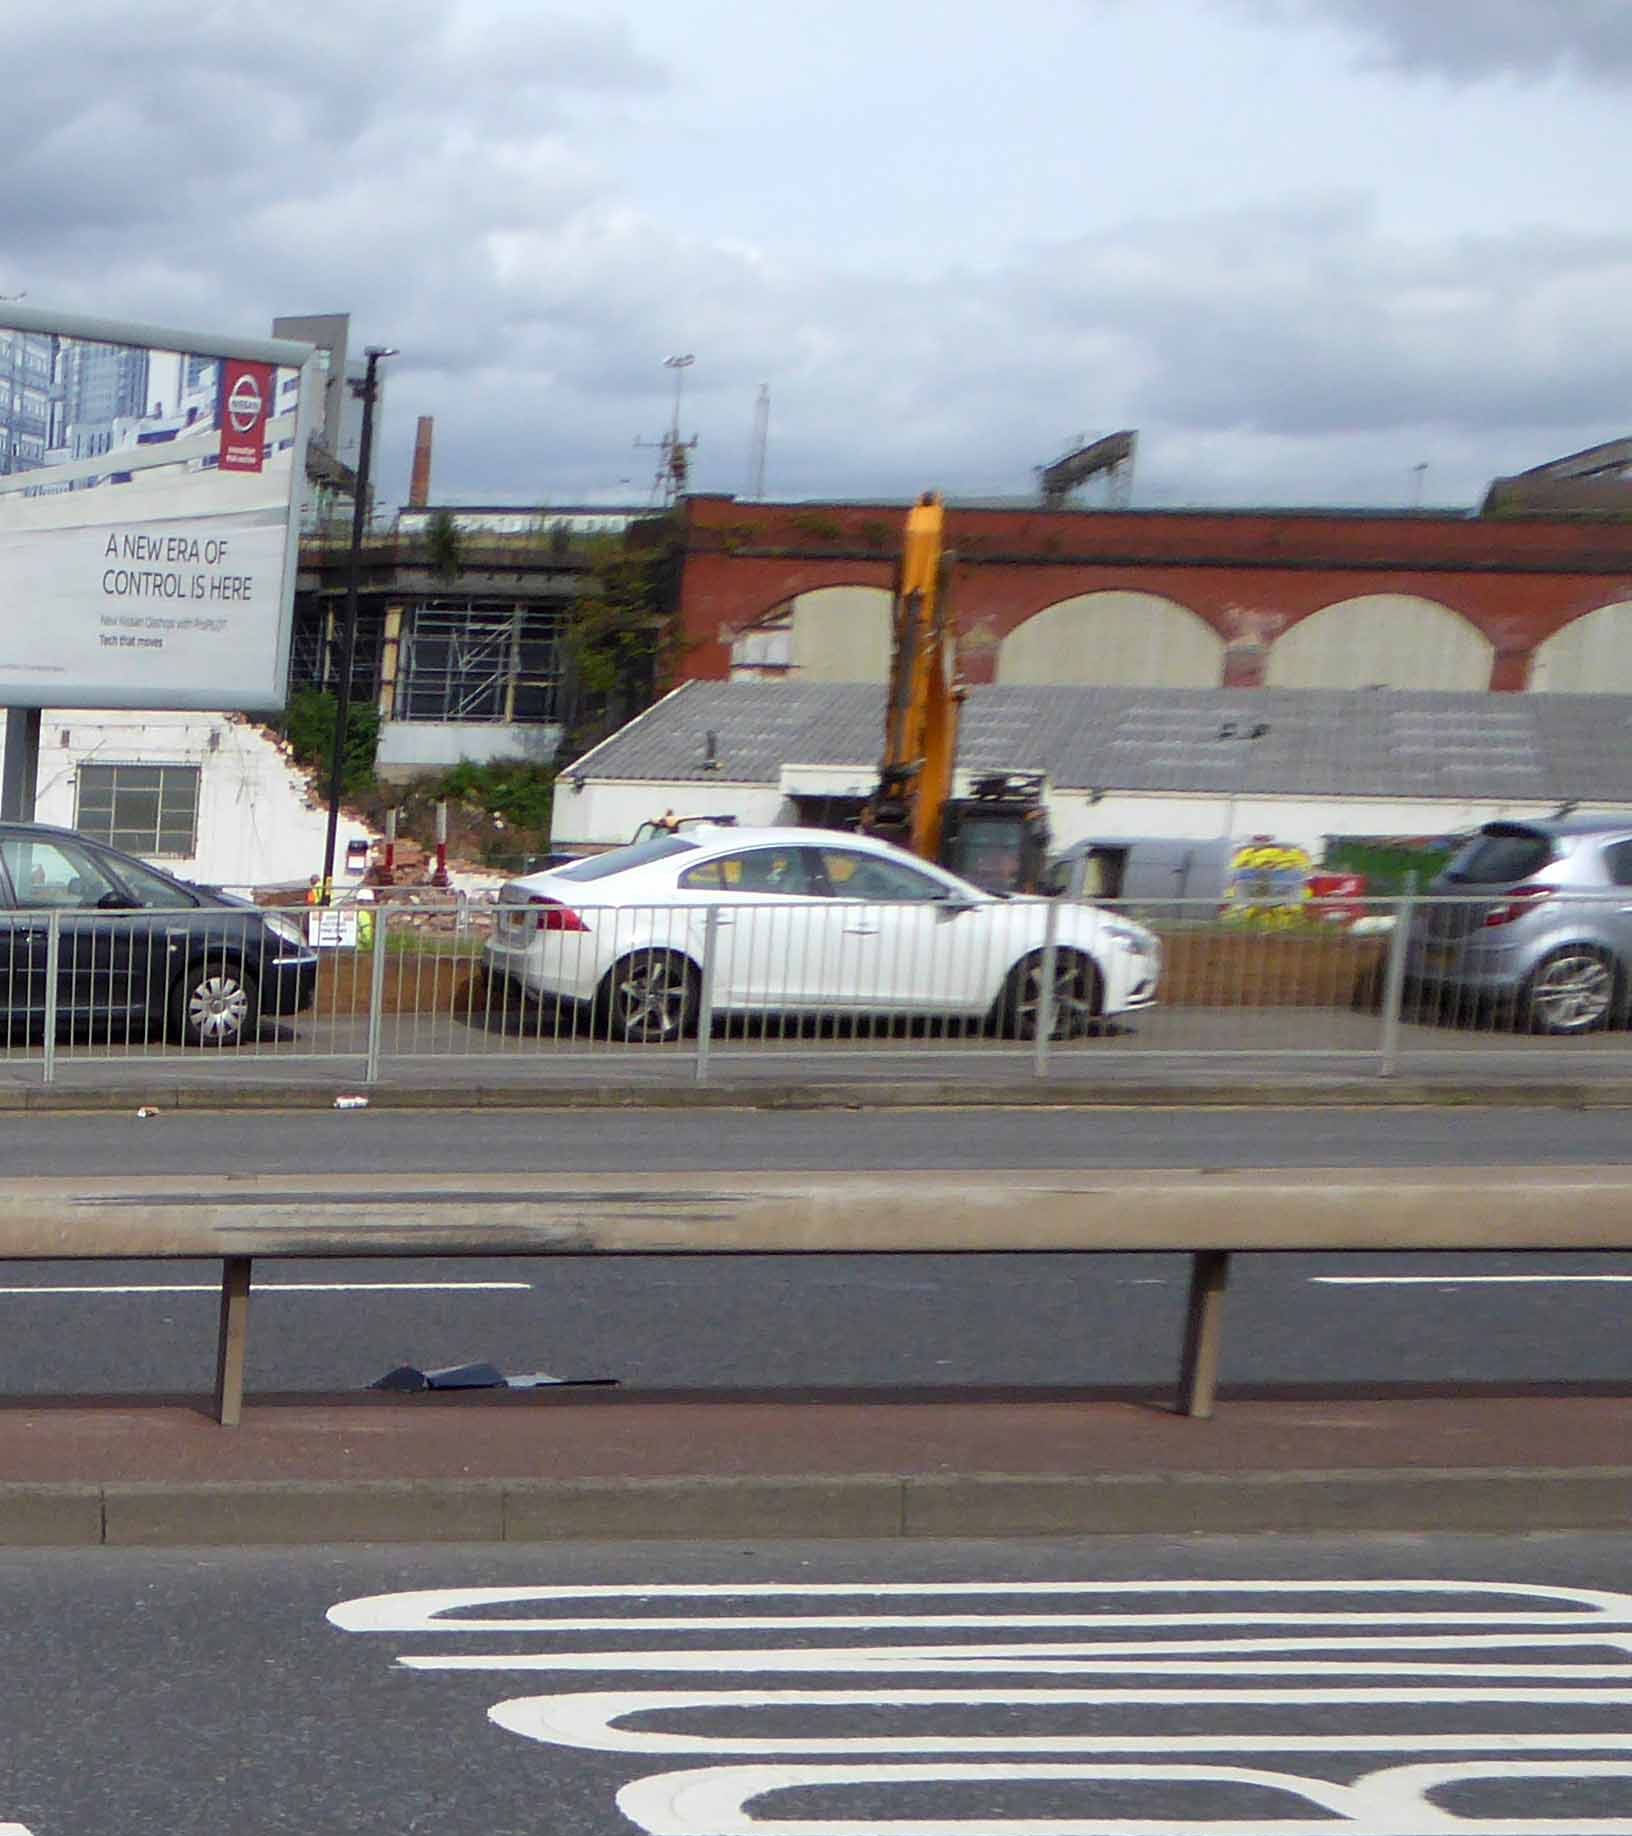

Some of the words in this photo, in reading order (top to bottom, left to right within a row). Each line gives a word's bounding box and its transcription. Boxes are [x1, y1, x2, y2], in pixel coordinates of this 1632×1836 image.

[104, 532, 119, 558] A
[122, 534, 163, 561] NEW
[167, 537, 200, 563] ERA
[204, 540, 229, 565] OF
[102, 569, 186, 598] CONTROL
[191, 574, 206, 600] IS
[210, 575, 254, 601] HERE
[99, 634, 118, 647] Tech
[119, 635, 136, 648] that
[137, 637, 163, 649] moves
